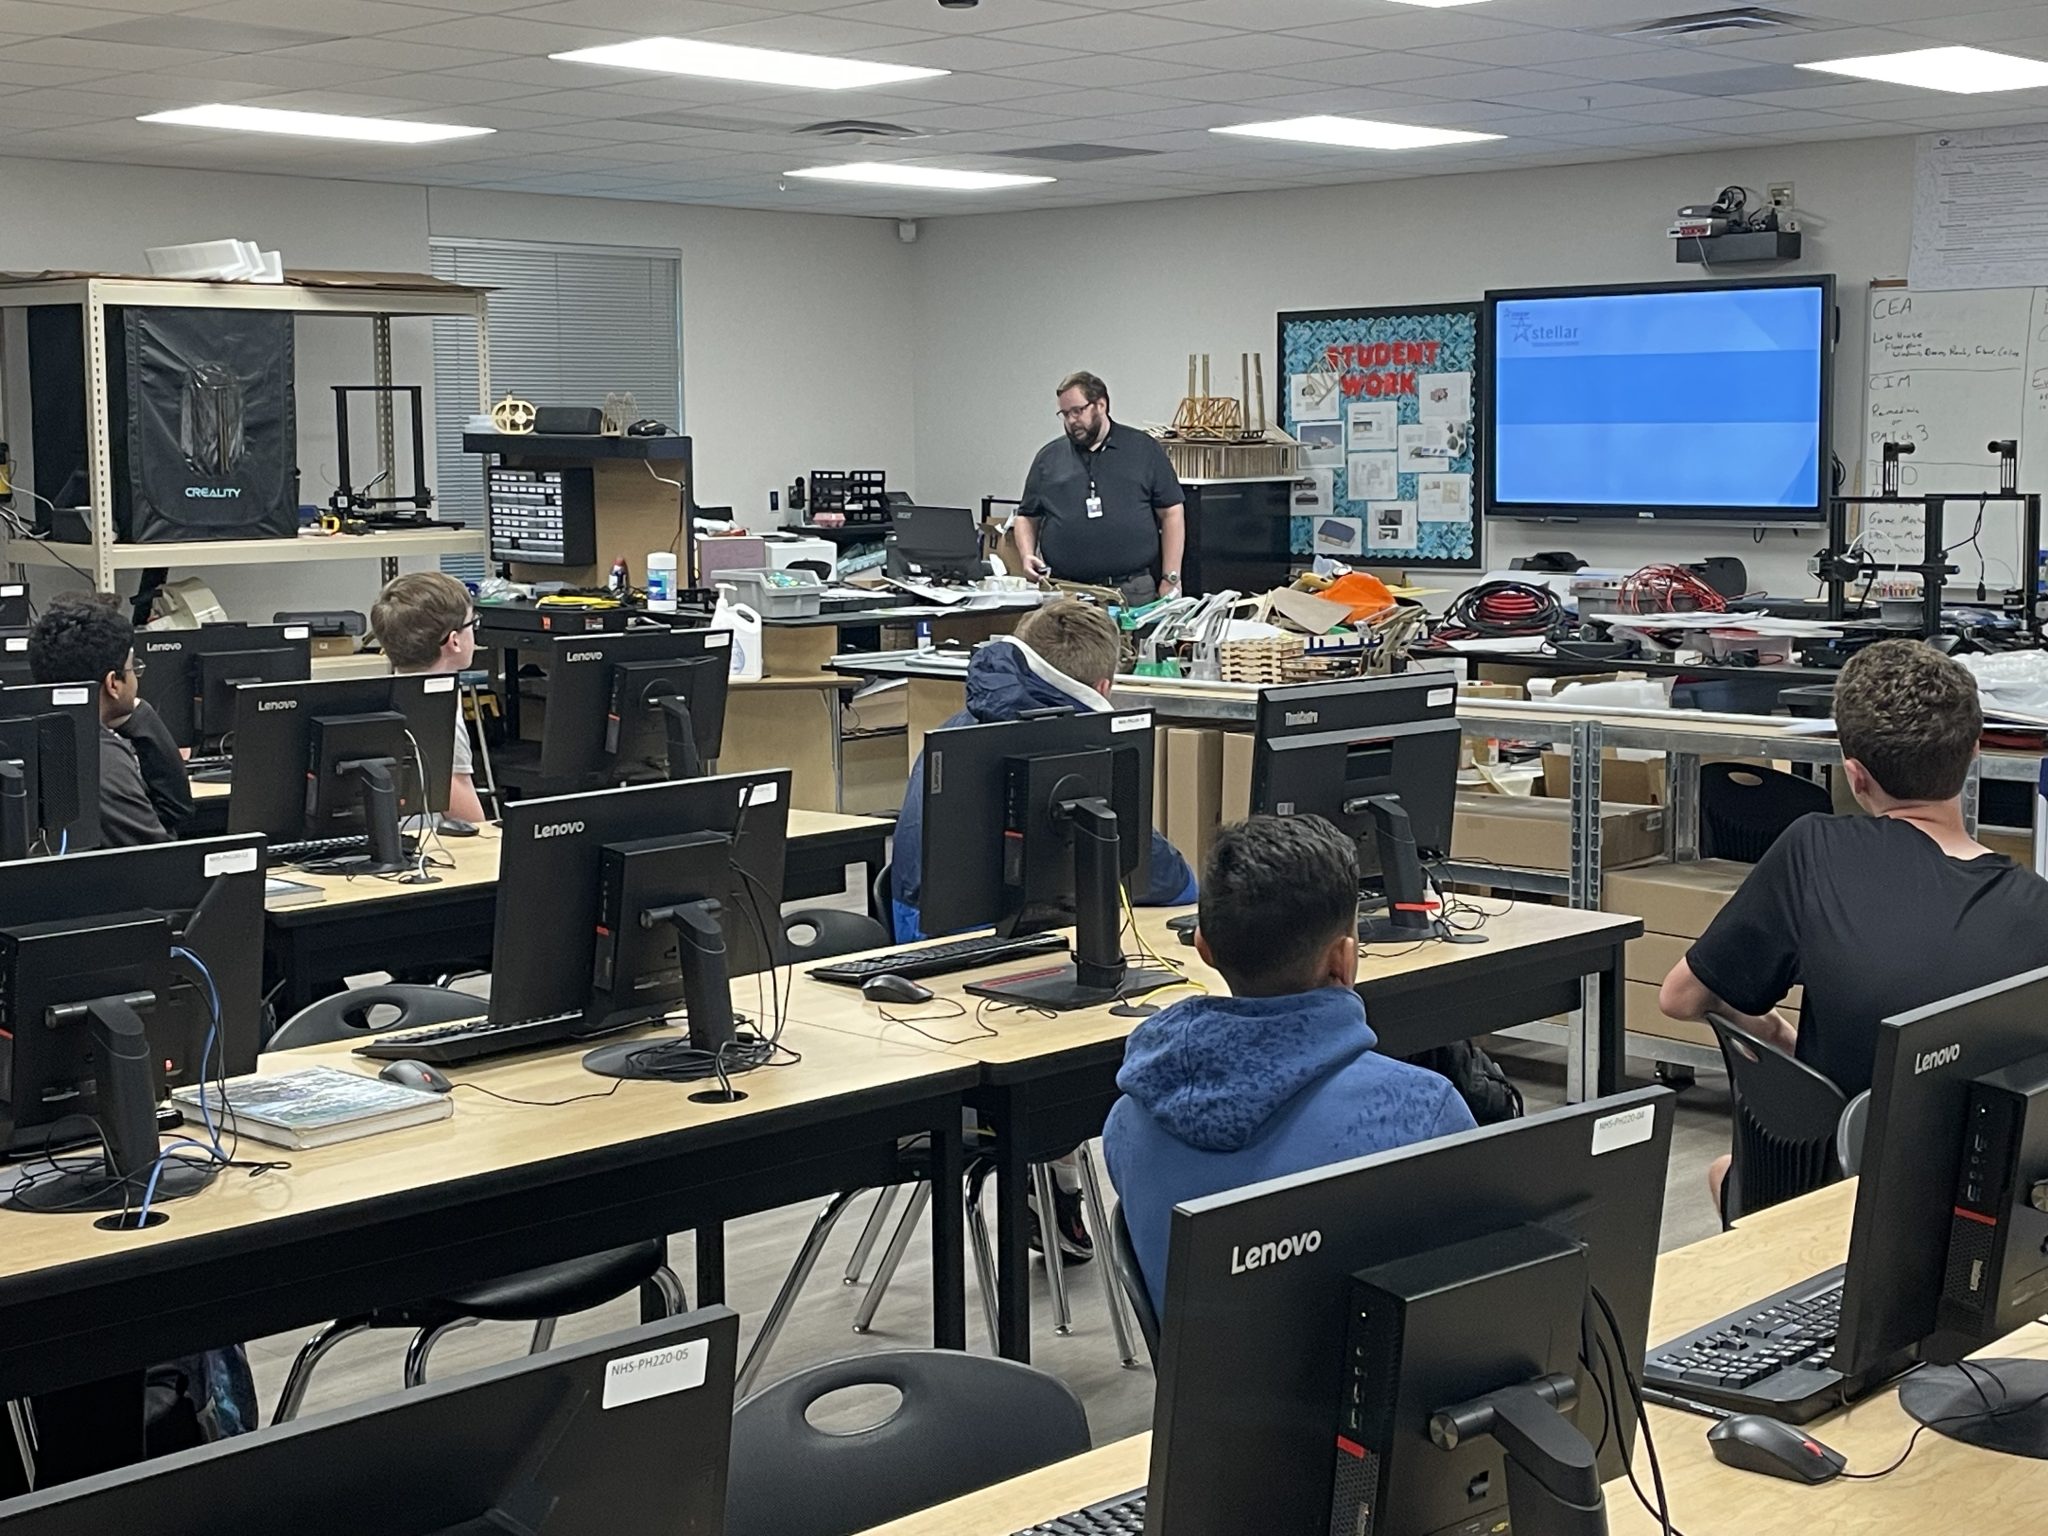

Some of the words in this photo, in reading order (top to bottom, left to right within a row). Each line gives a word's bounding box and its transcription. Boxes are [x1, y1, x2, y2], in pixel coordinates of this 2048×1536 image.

[1872, 297, 1912, 320] CEA
[1531, 325, 1579, 340] stellar
[1325, 340, 1440, 373] STUDENT
[1340, 370, 1419, 397] WORK
[1869, 374, 1911, 391] CIM
[1916, 423, 1929, 442] 3
[1870, 463, 1919, 486] ID
[184, 487, 242, 498] CREALITY
[146, 642, 182, 652] Lenovo
[566, 651, 604, 662] Lenovo
[258, 700, 298, 712] Lenovo
[533, 820, 586, 840] Lenovo
[1914, 1043, 1961, 1075] Lenovo
[1231, 1230, 1323, 1275] Lenovo
[611, 1347, 690, 1376] NHS-PH220-05
